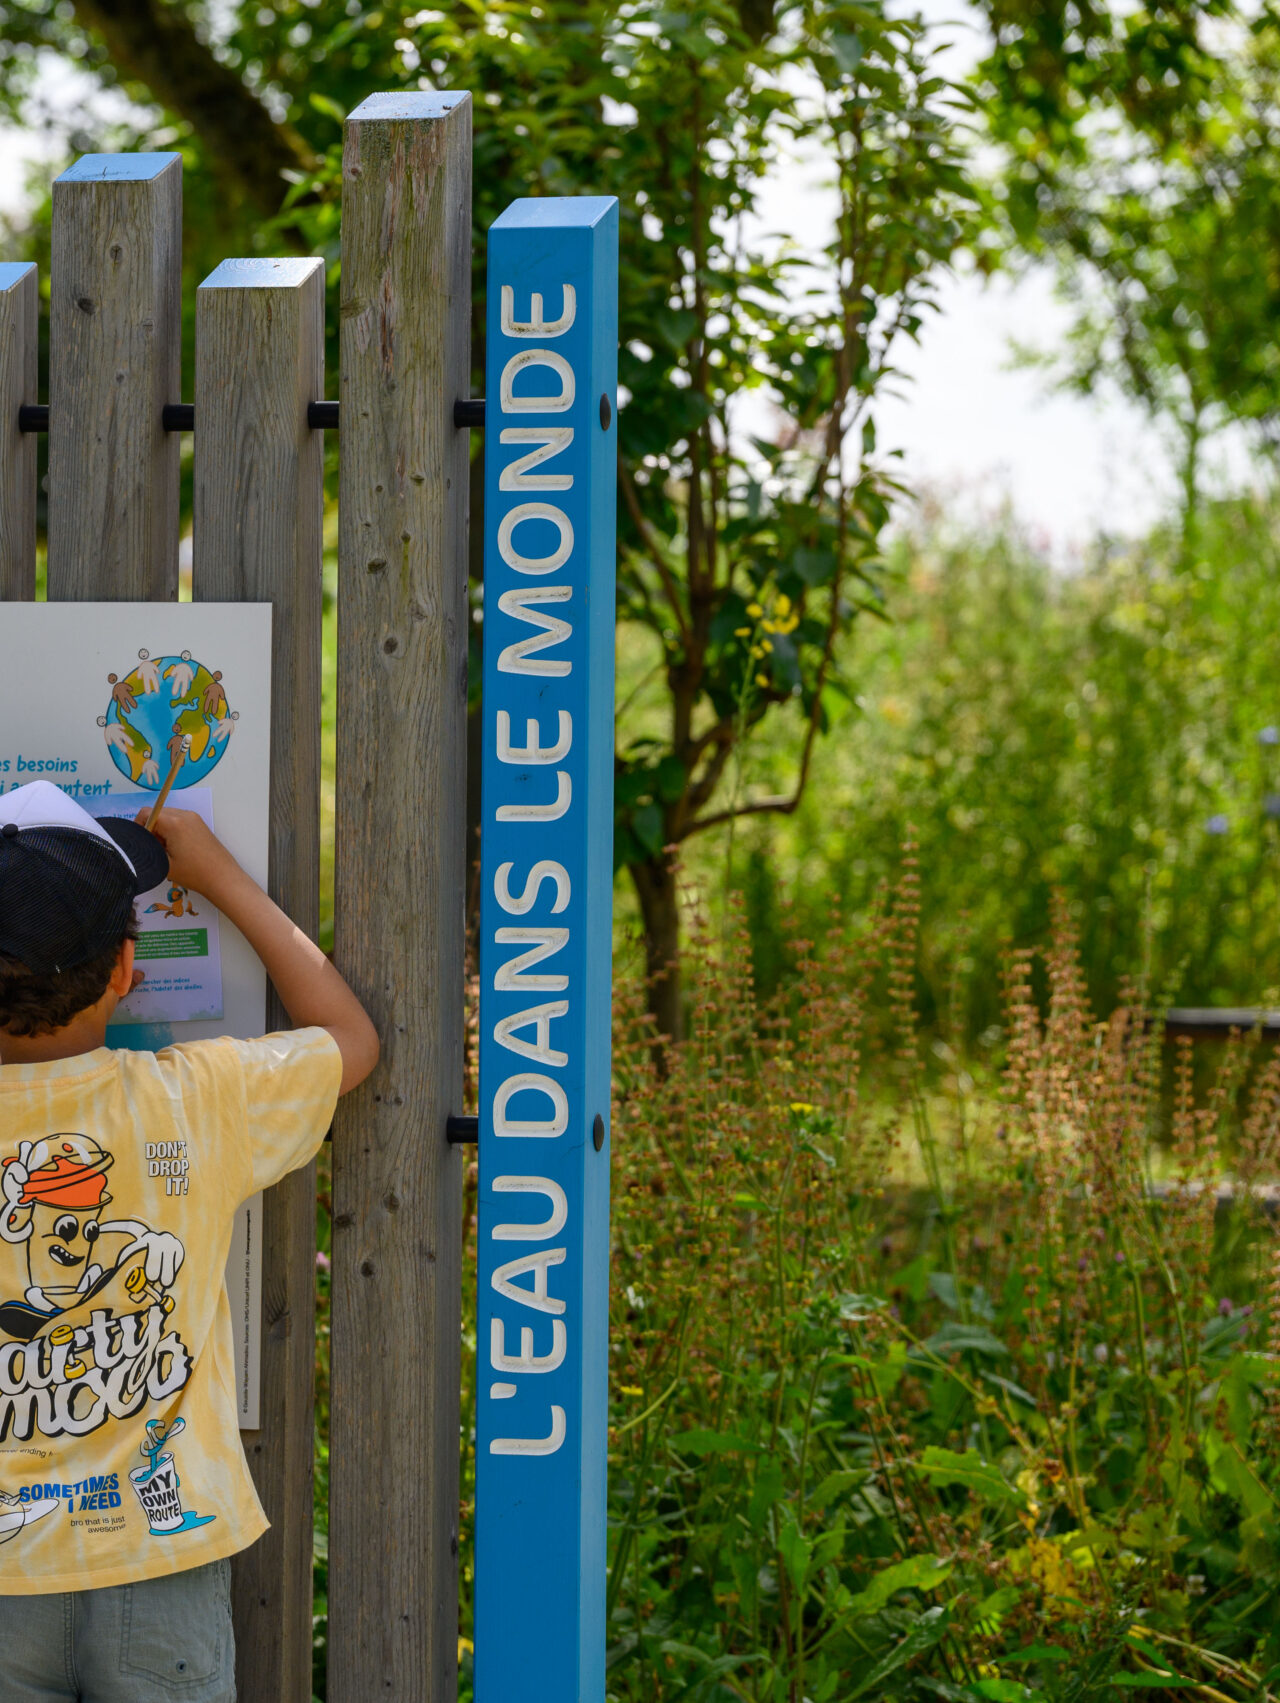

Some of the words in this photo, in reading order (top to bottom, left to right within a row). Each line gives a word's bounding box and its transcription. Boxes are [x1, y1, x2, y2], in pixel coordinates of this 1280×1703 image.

[496, 283, 577, 678] MONDE
[17, 755, 78, 773] besoins
[495, 709, 573, 822] LE
[492, 859, 571, 1139] DANS
[145, 1141, 188, 1160] DON'T
[148, 1159, 190, 1177] DROP
[166, 1177, 190, 1196] IT!
[488, 1175, 569, 1457] L'EAU
[19, 1473, 119, 1502] SOMETIMES
[139, 1470, 172, 1496] MY
[68, 1498, 74, 1514] I
[79, 1492, 122, 1512] NEED
[142, 1488, 176, 1508] OWN
[85, 1518, 100, 1526] that
[111, 1516, 125, 1524] just
[148, 1502, 179, 1522] ROUTE
